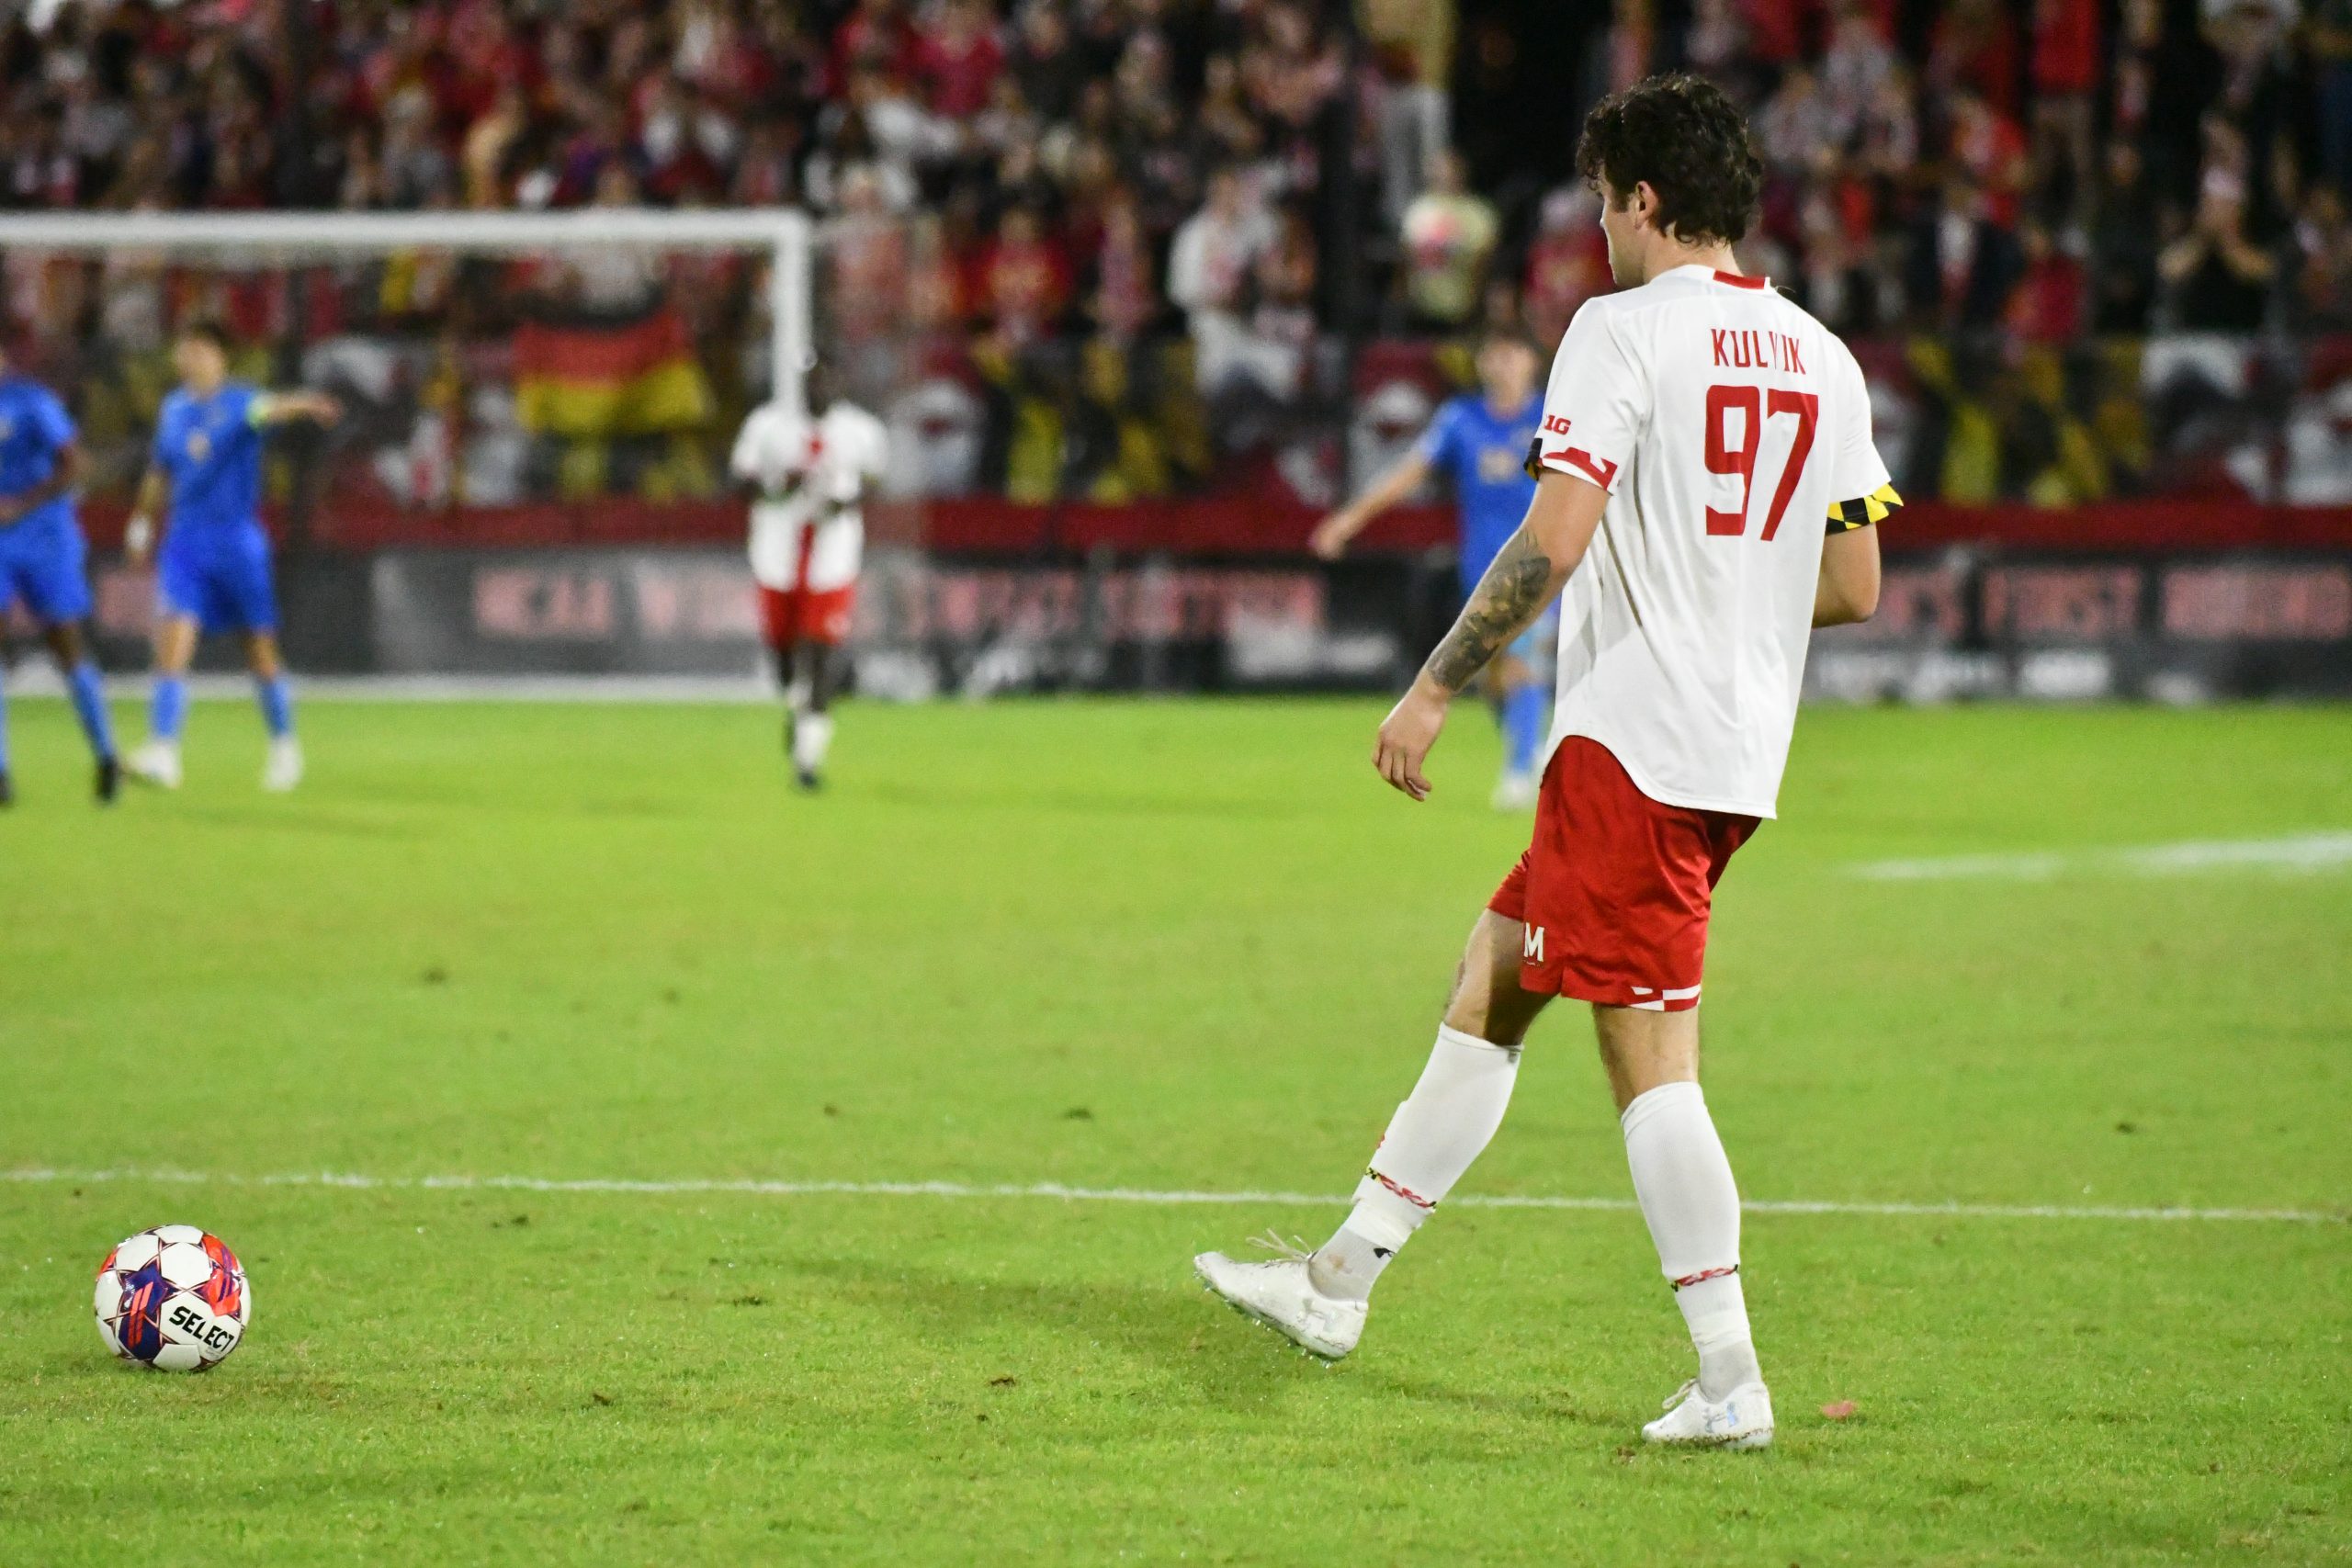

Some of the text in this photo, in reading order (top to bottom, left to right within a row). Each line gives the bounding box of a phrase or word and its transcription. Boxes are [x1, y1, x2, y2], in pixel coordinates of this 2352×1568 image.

[1704, 384, 1818, 542] 97
[1523, 921, 1544, 962] M
[169, 1305, 235, 1353] SELECT
